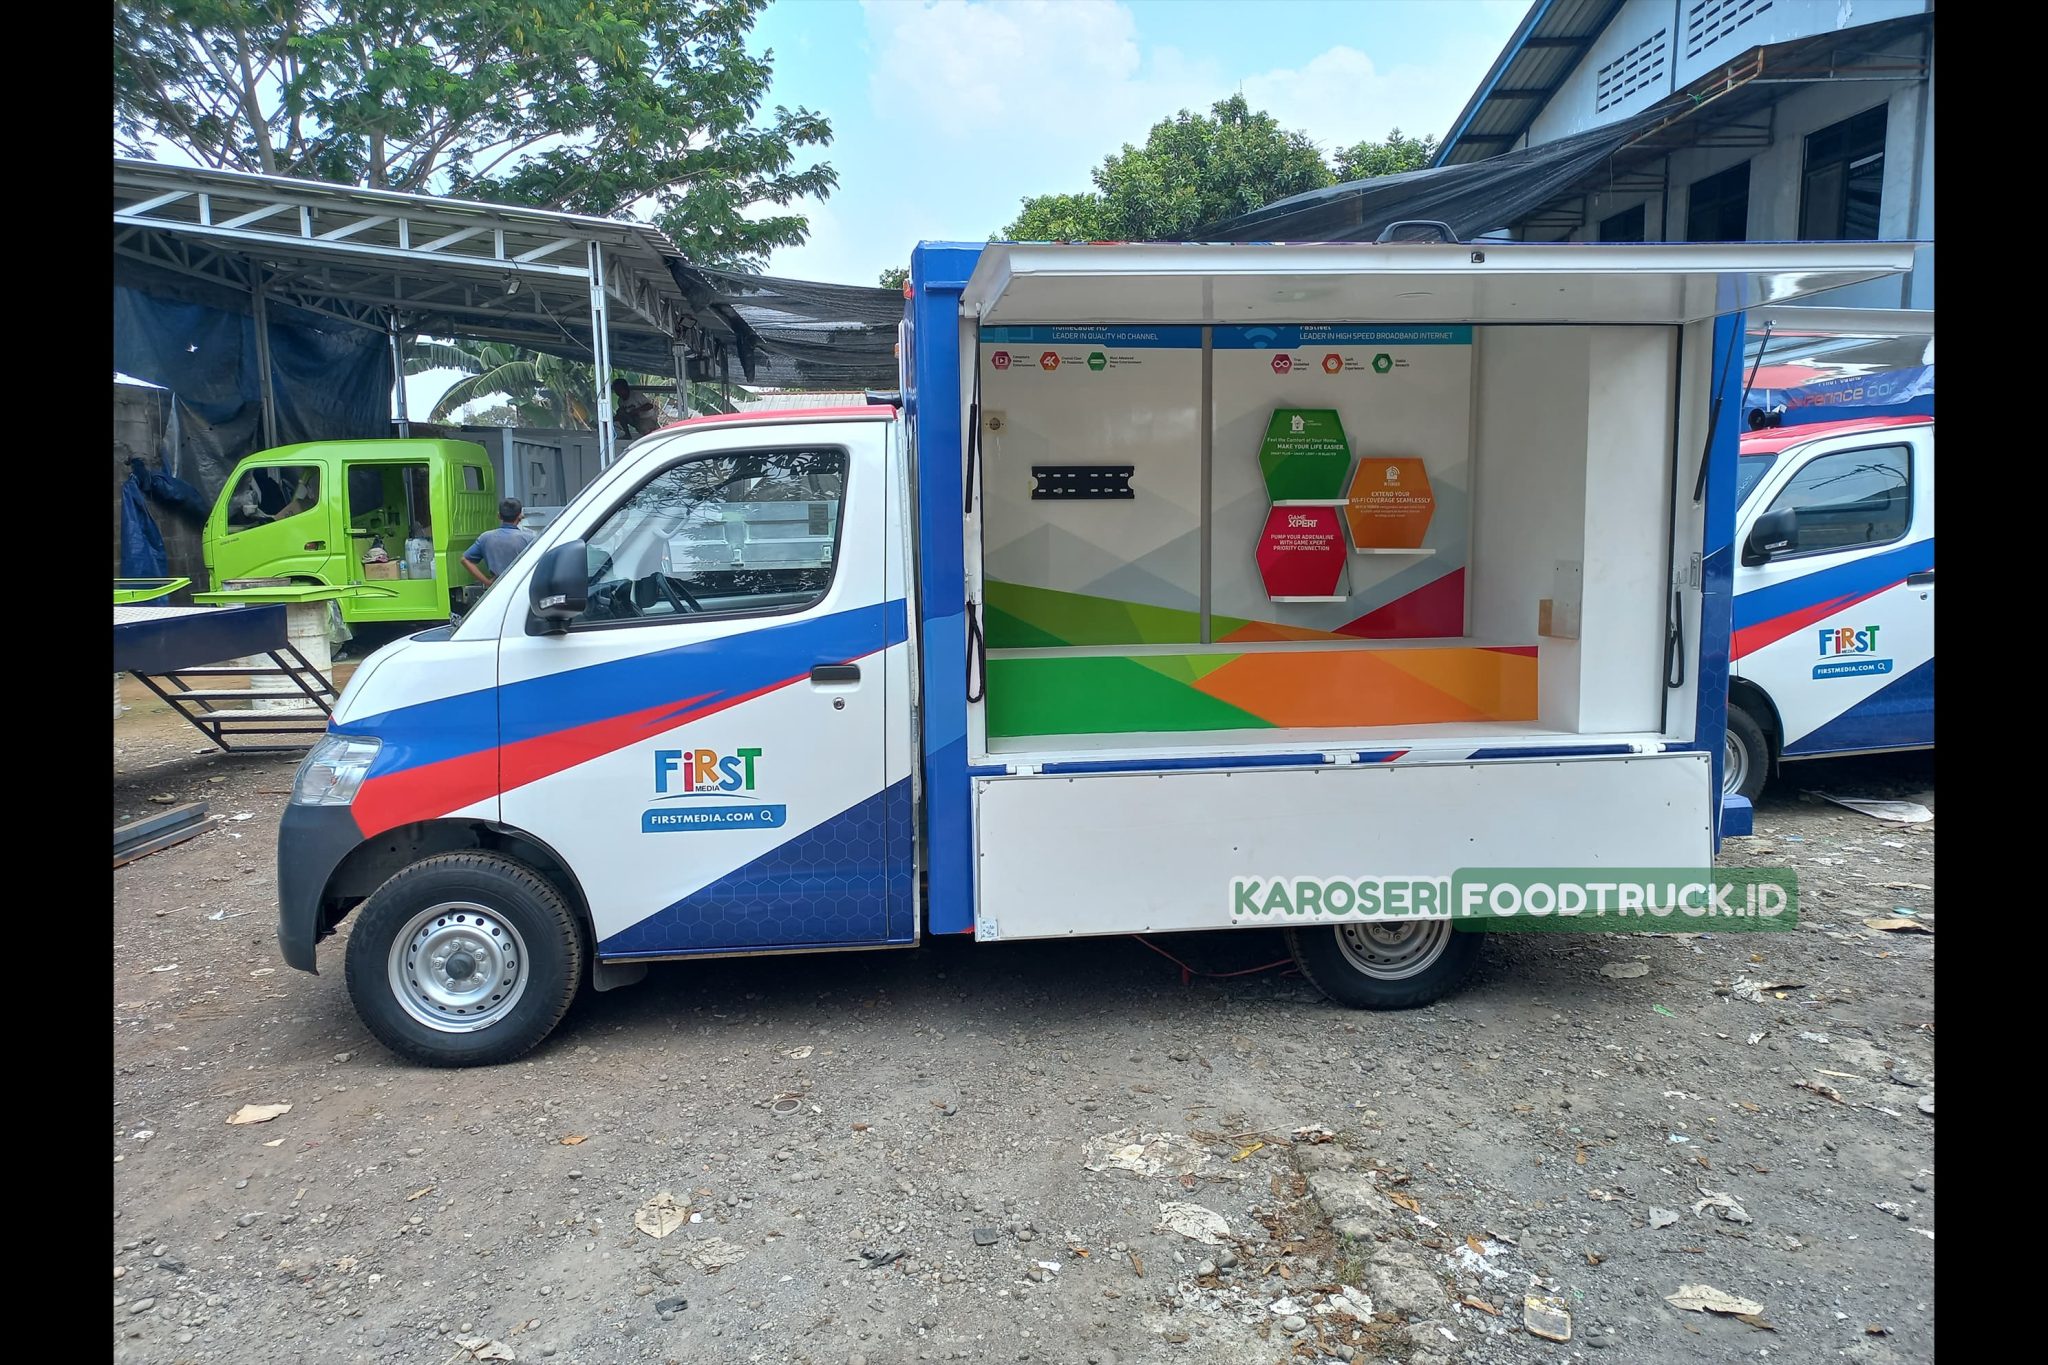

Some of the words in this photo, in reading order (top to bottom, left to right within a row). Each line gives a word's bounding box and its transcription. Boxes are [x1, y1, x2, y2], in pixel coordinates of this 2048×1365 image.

[1052, 332, 1078, 340] LEADER
[1079, 332, 1087, 340] IN
[1088, 332, 1116, 340] QUALITY
[1116, 332, 1126, 340] HD
[1127, 332, 1159, 340] CHANNEL
[1299, 332, 1326, 340] LEADER
[1327, 332, 1335, 340] IN
[1336, 332, 1351, 340] HIGH
[1352, 332, 1375, 340] SPEED
[1376, 332, 1418, 340] BROADBAND
[1419, 332, 1453, 340] INTERNET
[1288, 519, 1318, 528] XPERT
[1817, 664, 1875, 675] FIRSTMEDIA.COM
[650, 812, 755, 825] FIRSTMEDIA.COM
